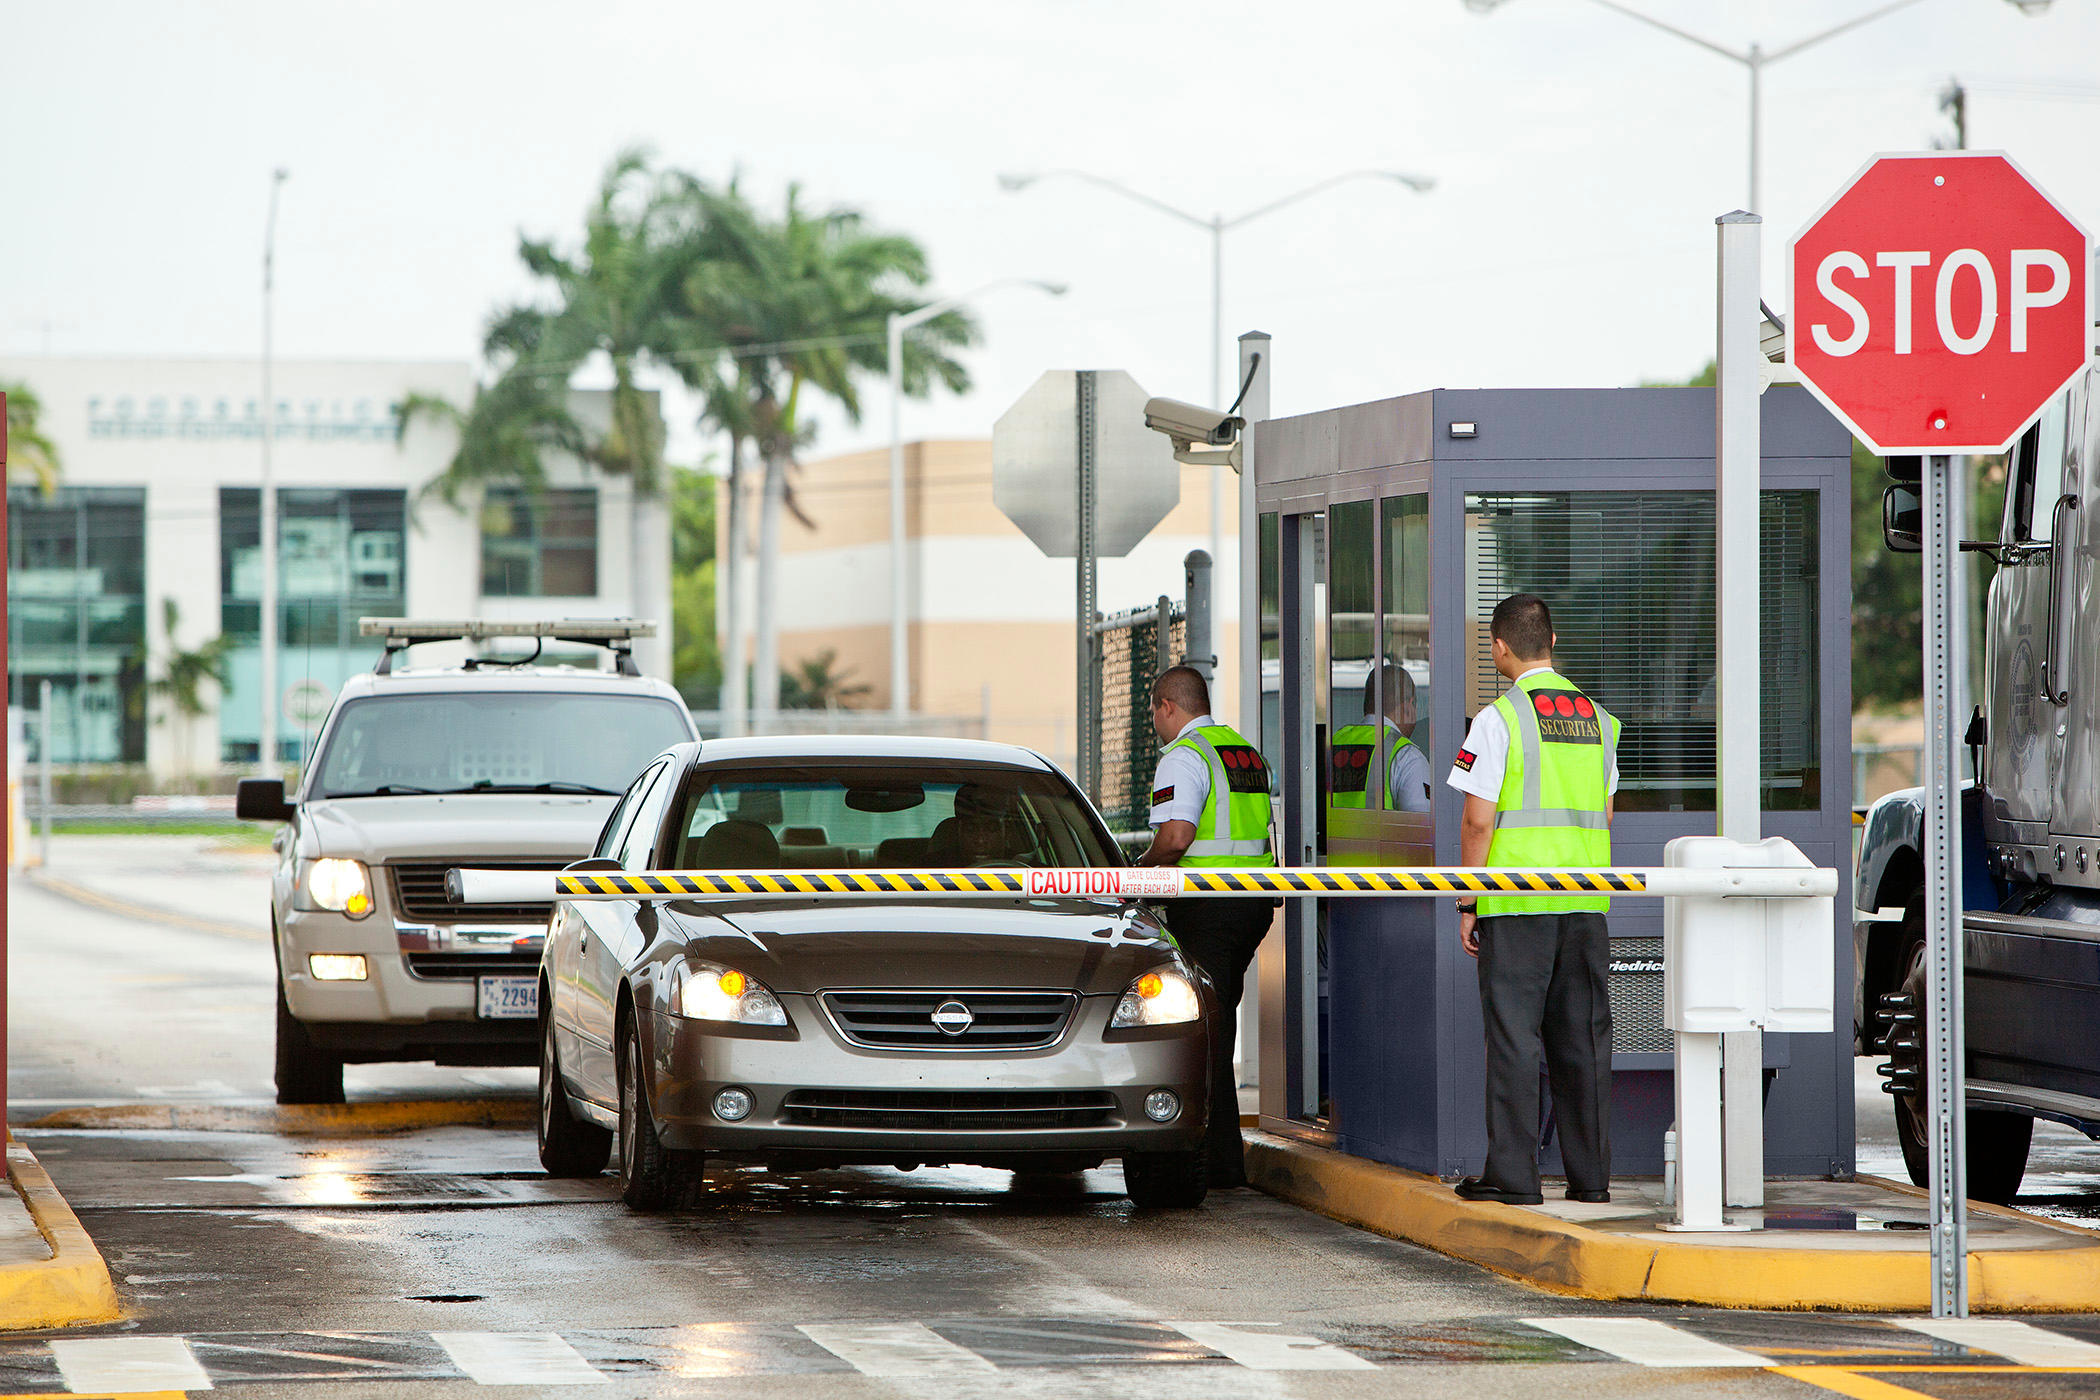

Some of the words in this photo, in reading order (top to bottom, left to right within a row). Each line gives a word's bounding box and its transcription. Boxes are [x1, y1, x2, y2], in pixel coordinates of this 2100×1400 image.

[1811, 248, 2071, 357] STOP
[1540, 718, 1600, 737] SECURITAS
[1229, 770, 1267, 787] SECURITA
[1031, 871, 1120, 894] CAUTION
[1126, 871, 1144, 880] GATE
[1145, 871, 1171, 880] CLOSES
[1121, 883, 1142, 894] AFTER
[1144, 883, 1161, 894] EACH
[1163, 883, 1177, 894] CAR
[1608, 960, 1665, 972] riedric
[502, 987, 537, 1006] 2294
